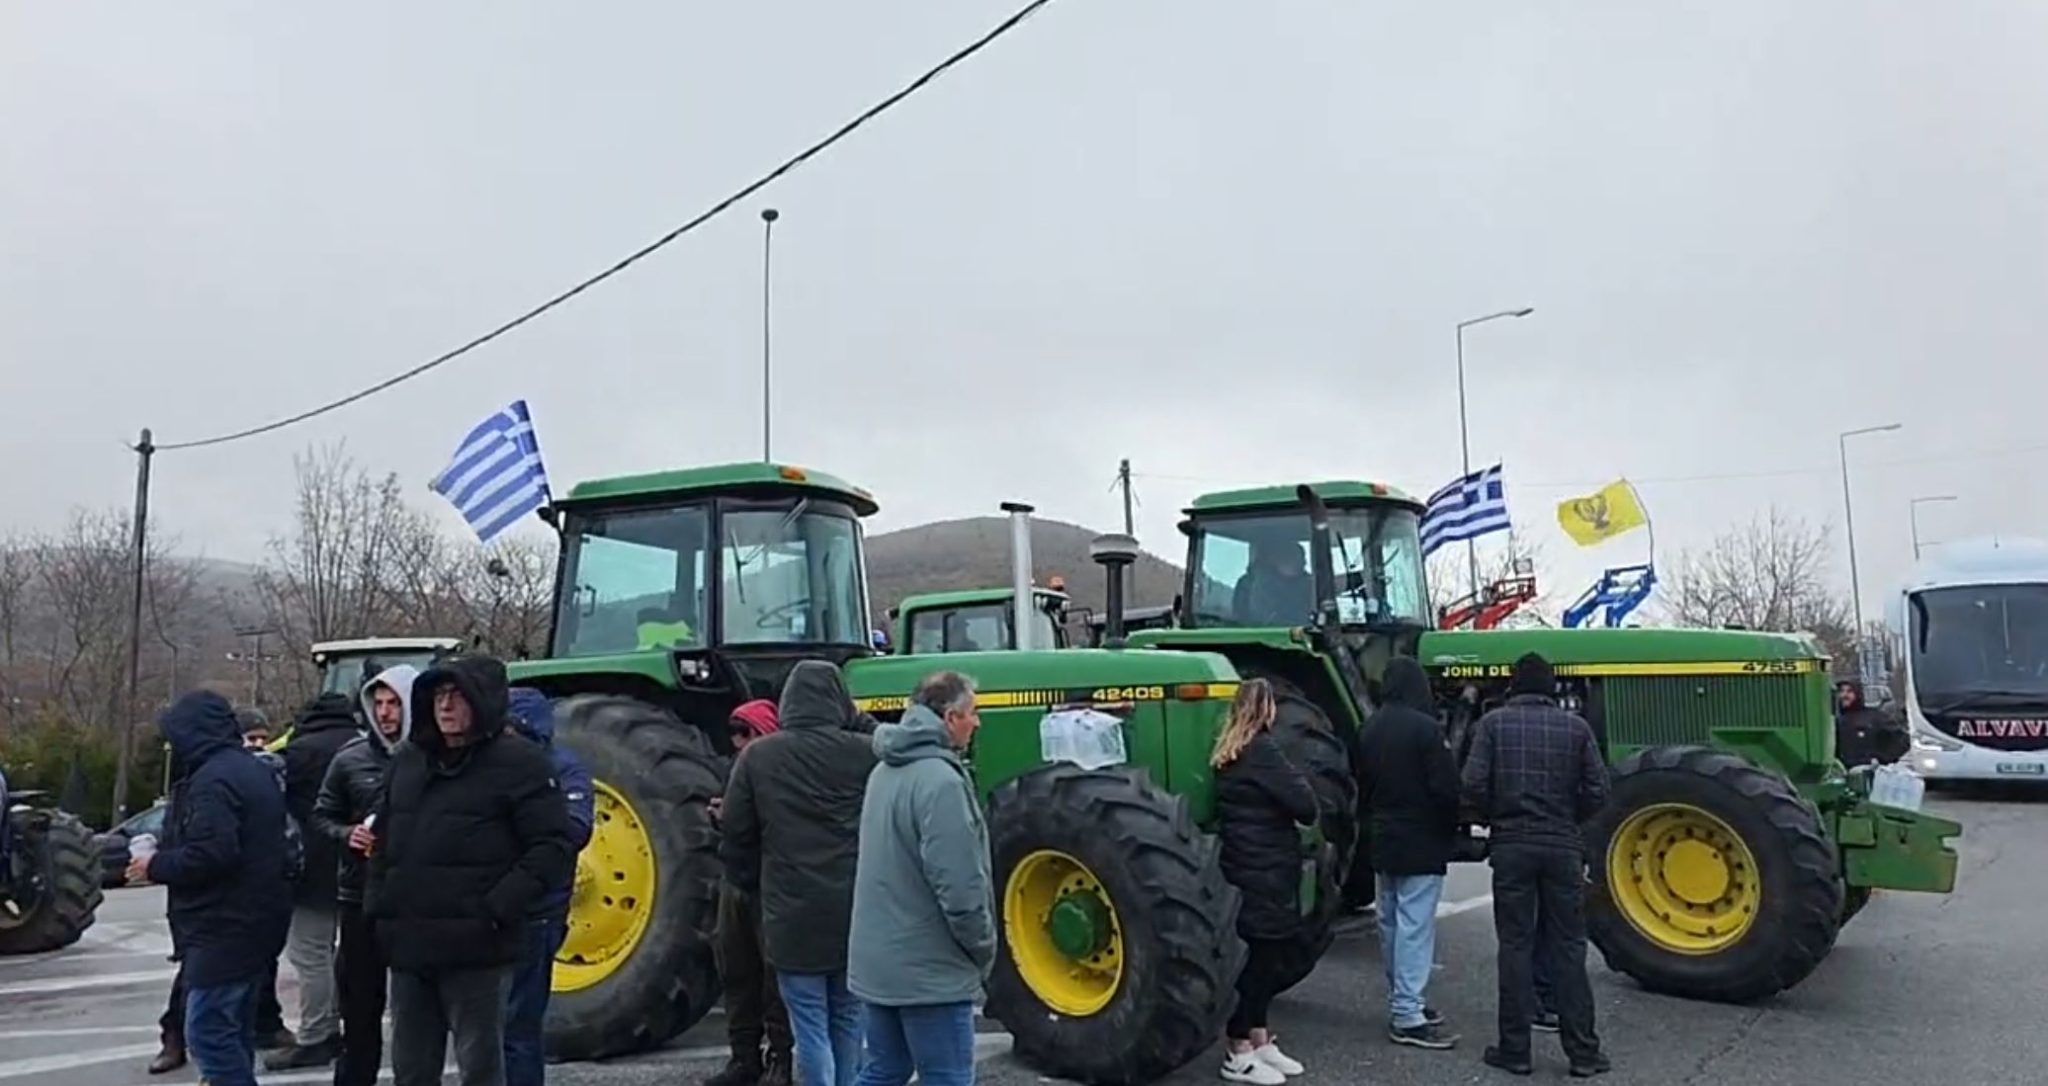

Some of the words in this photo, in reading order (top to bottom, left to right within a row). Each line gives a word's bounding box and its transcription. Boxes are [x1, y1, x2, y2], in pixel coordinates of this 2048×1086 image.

[1442, 665, 1484, 677] JOHN
[1742, 661, 1798, 672] 4755
[1092, 686, 1164, 700] 4240S
[870, 698, 904, 710] JOHN
[1957, 719, 2048, 737] ALVAV
